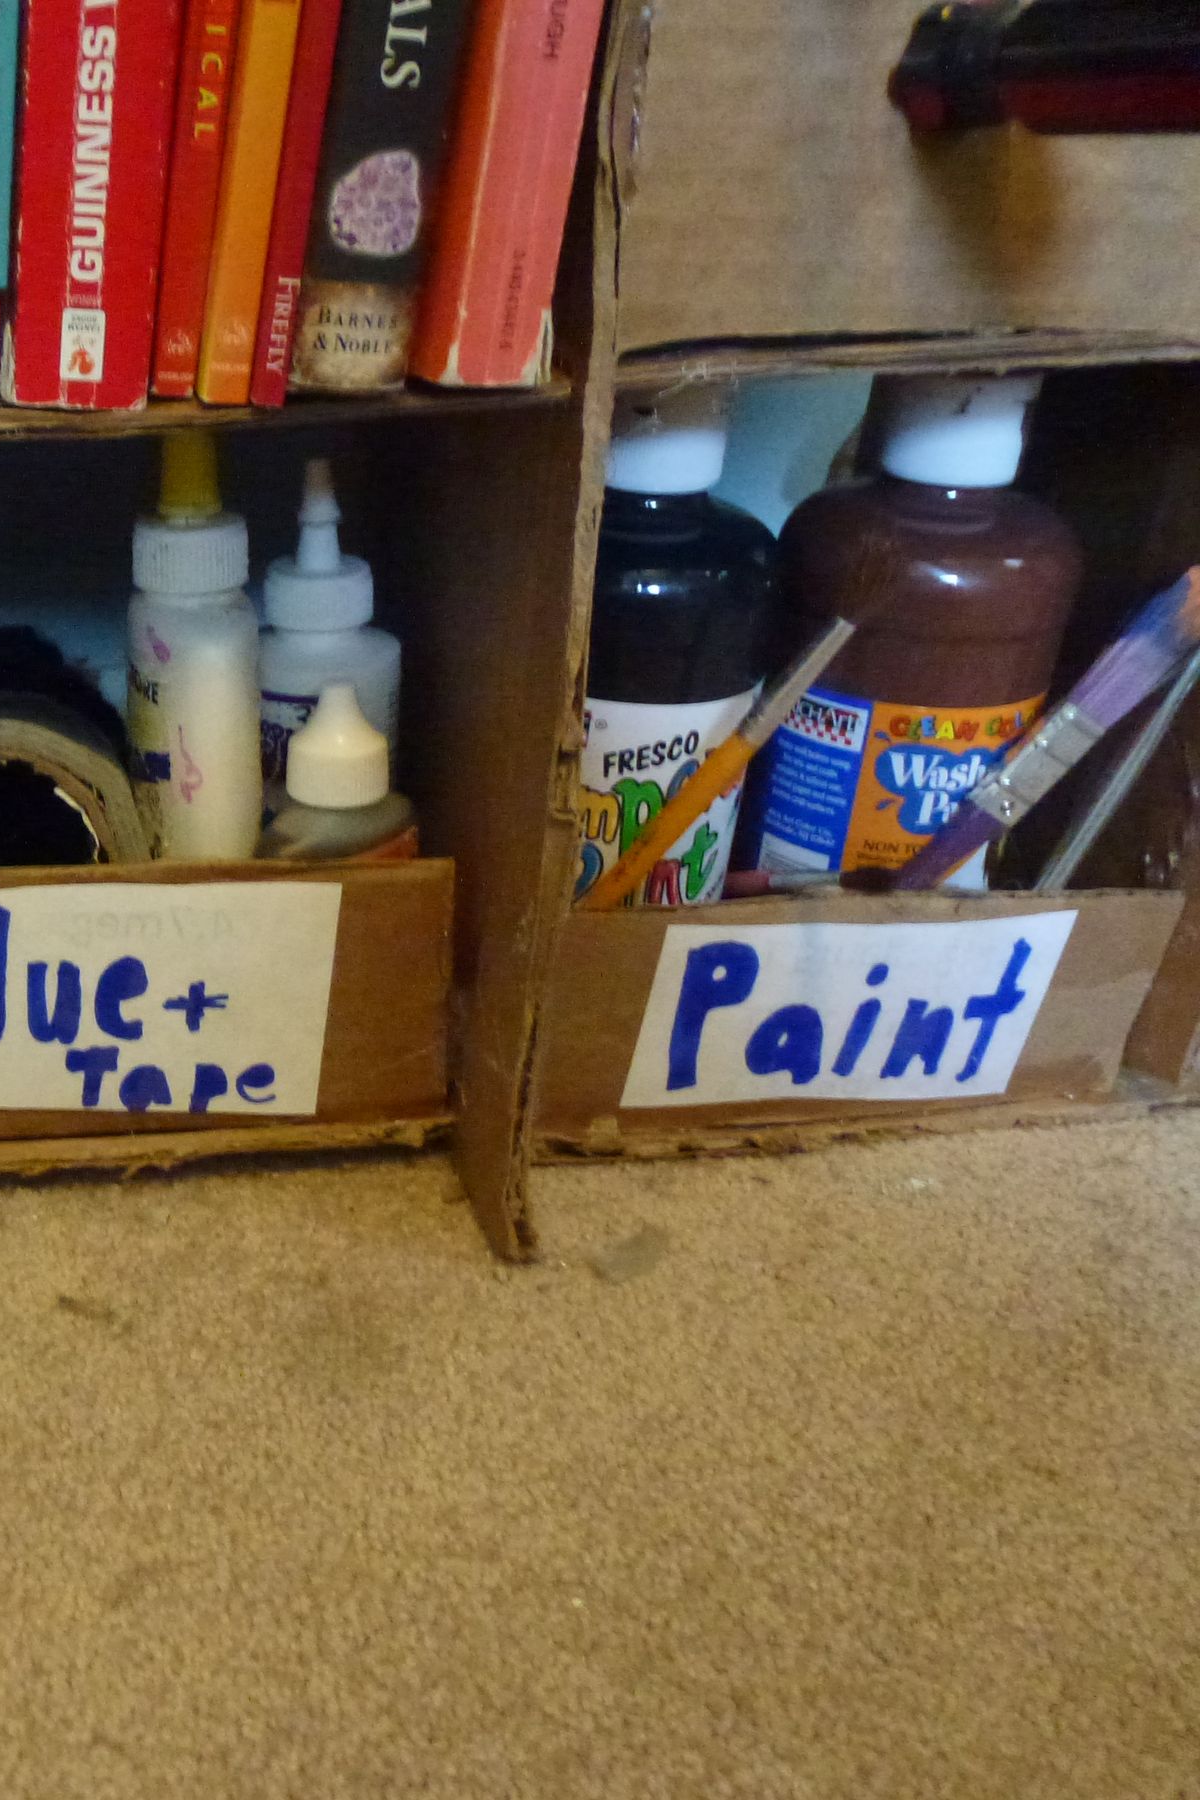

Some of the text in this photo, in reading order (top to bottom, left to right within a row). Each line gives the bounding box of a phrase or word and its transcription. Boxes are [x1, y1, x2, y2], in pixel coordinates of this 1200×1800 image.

[69, 24, 118, 282] GUINNESS
[266, 276, 301, 375] FIREFLY
[318, 305, 398, 329] BARNES
[313, 332, 393, 354] & NOBLE
[889, 714, 980, 742] CLEAN
[603, 730, 700, 778] FRESCO
[887, 751, 988, 792] Wash
[666, 938, 1032, 1091] Paint
[65, 1046, 276, 1113] Tape
